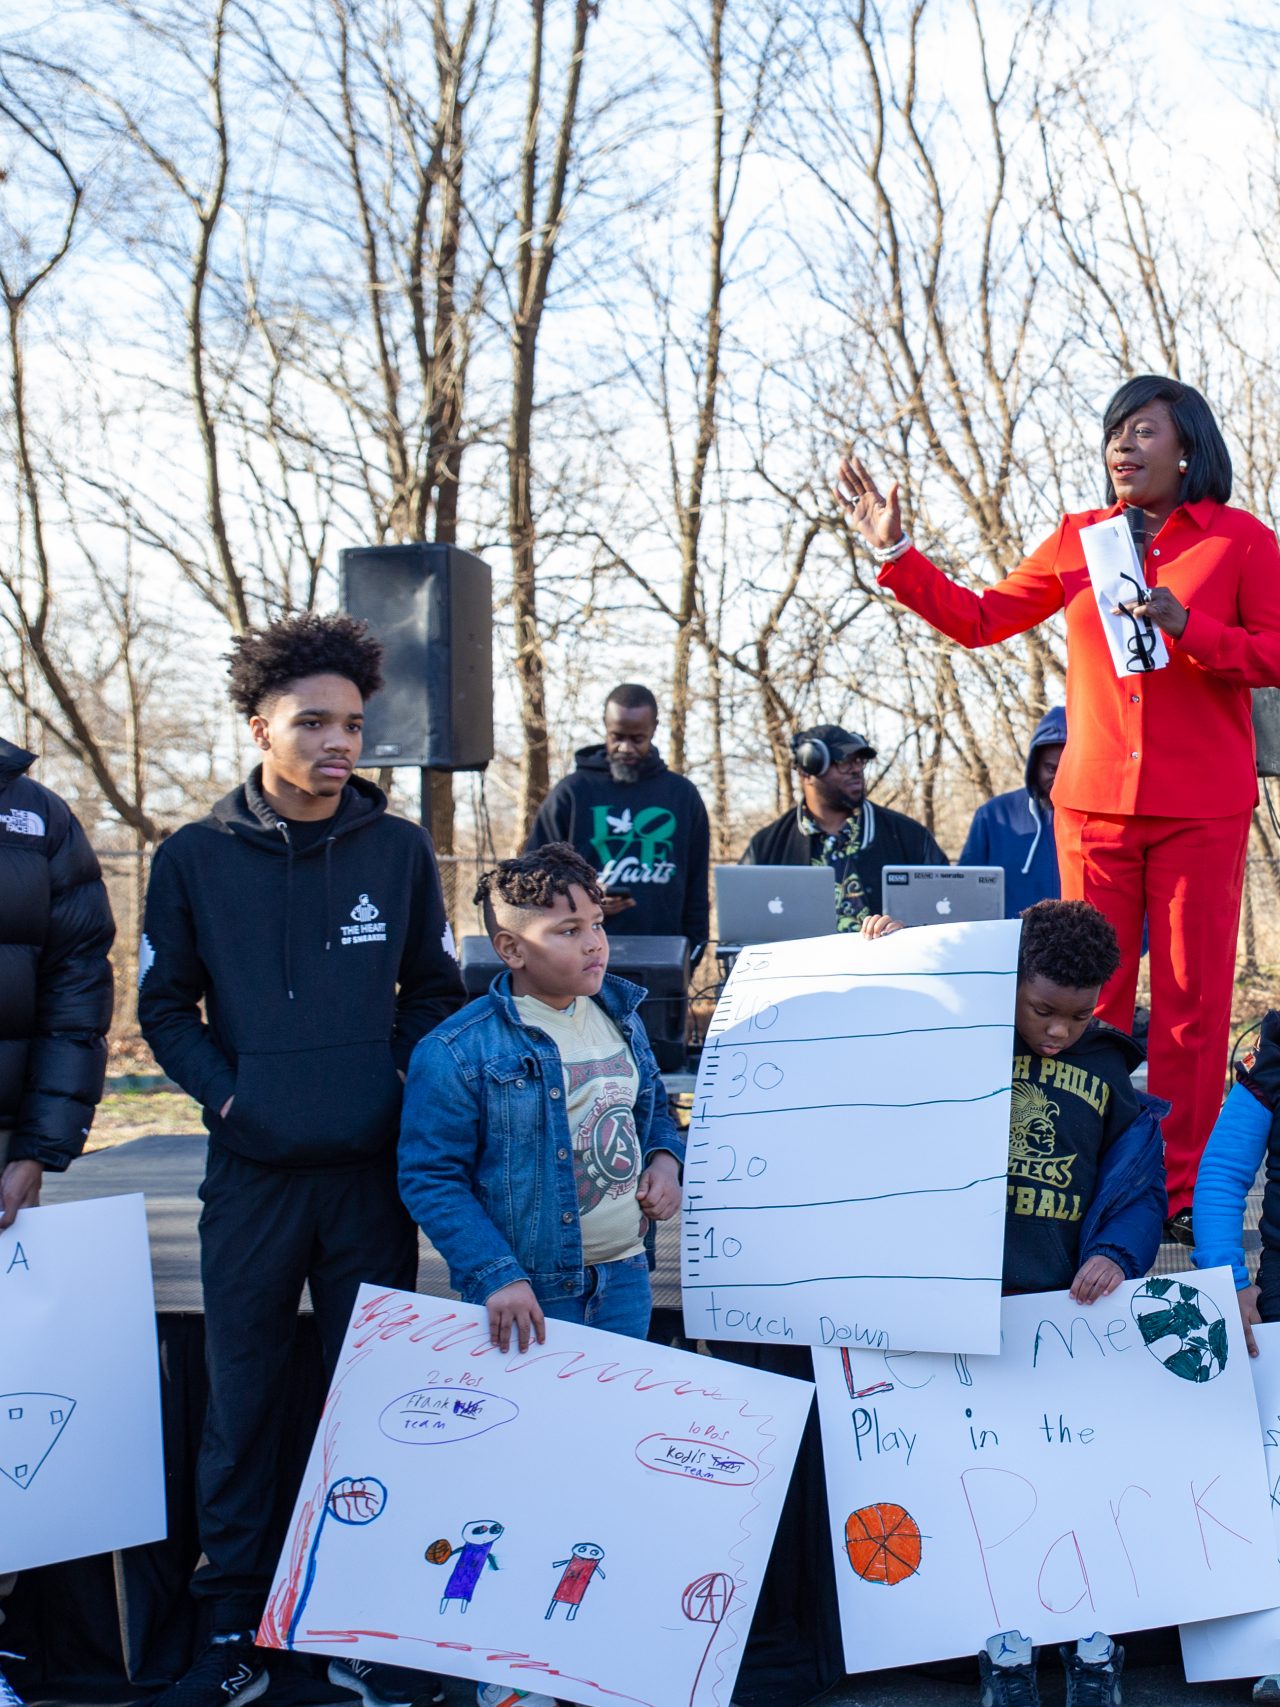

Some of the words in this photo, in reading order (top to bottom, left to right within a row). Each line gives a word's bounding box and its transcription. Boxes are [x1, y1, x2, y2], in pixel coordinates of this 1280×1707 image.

[6, 823, 28, 834] FACE
[10, 808, 28, 818] THE
[595, 856, 677, 886] Hurts
[340, 925, 360, 936] THE
[341, 937, 353, 945] OF
[728, 1052, 784, 1098] 30
[717, 1145, 767, 1182] 20
[7, 1241, 29, 1274] A
[704, 1227, 741, 1258] 10
[820, 1315, 890, 1350] Down
[852, 1407, 917, 1465] Play
[964, 1407, 999, 1450] in
[1039, 1413, 1096, 1445] the
